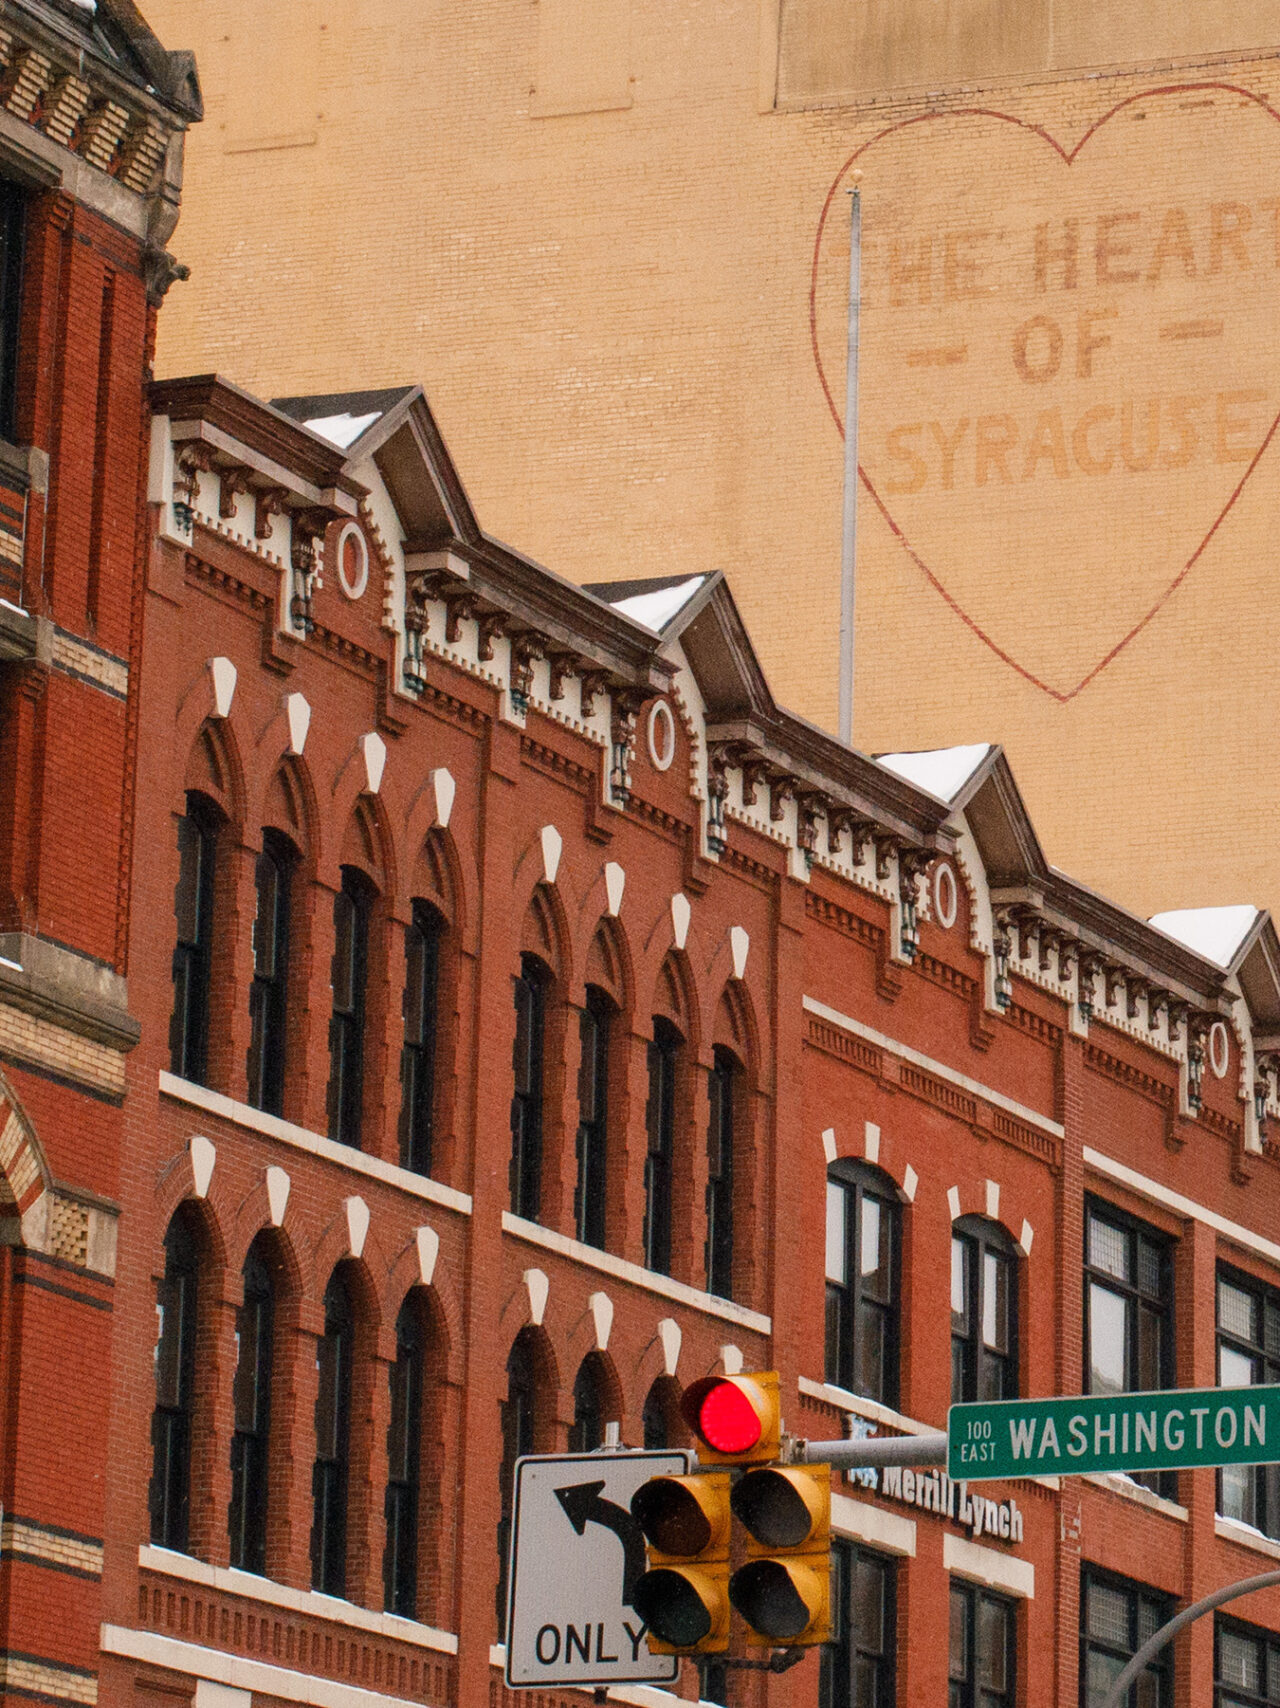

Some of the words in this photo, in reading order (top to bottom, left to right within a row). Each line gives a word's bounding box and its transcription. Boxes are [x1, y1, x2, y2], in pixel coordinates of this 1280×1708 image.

[1011, 307, 1119, 384] OF
[884, 390, 1268, 496] SYRACUSE
[960, 1442, 996, 1463] EAST
[967, 1420, 992, 1440] 100
[1009, 1404, 1267, 1461] WASHINGTON
[882, 1466, 955, 1519] Merrill
[959, 1482, 1024, 1543] Lynch
[536, 1622, 648, 1665] ONLY
